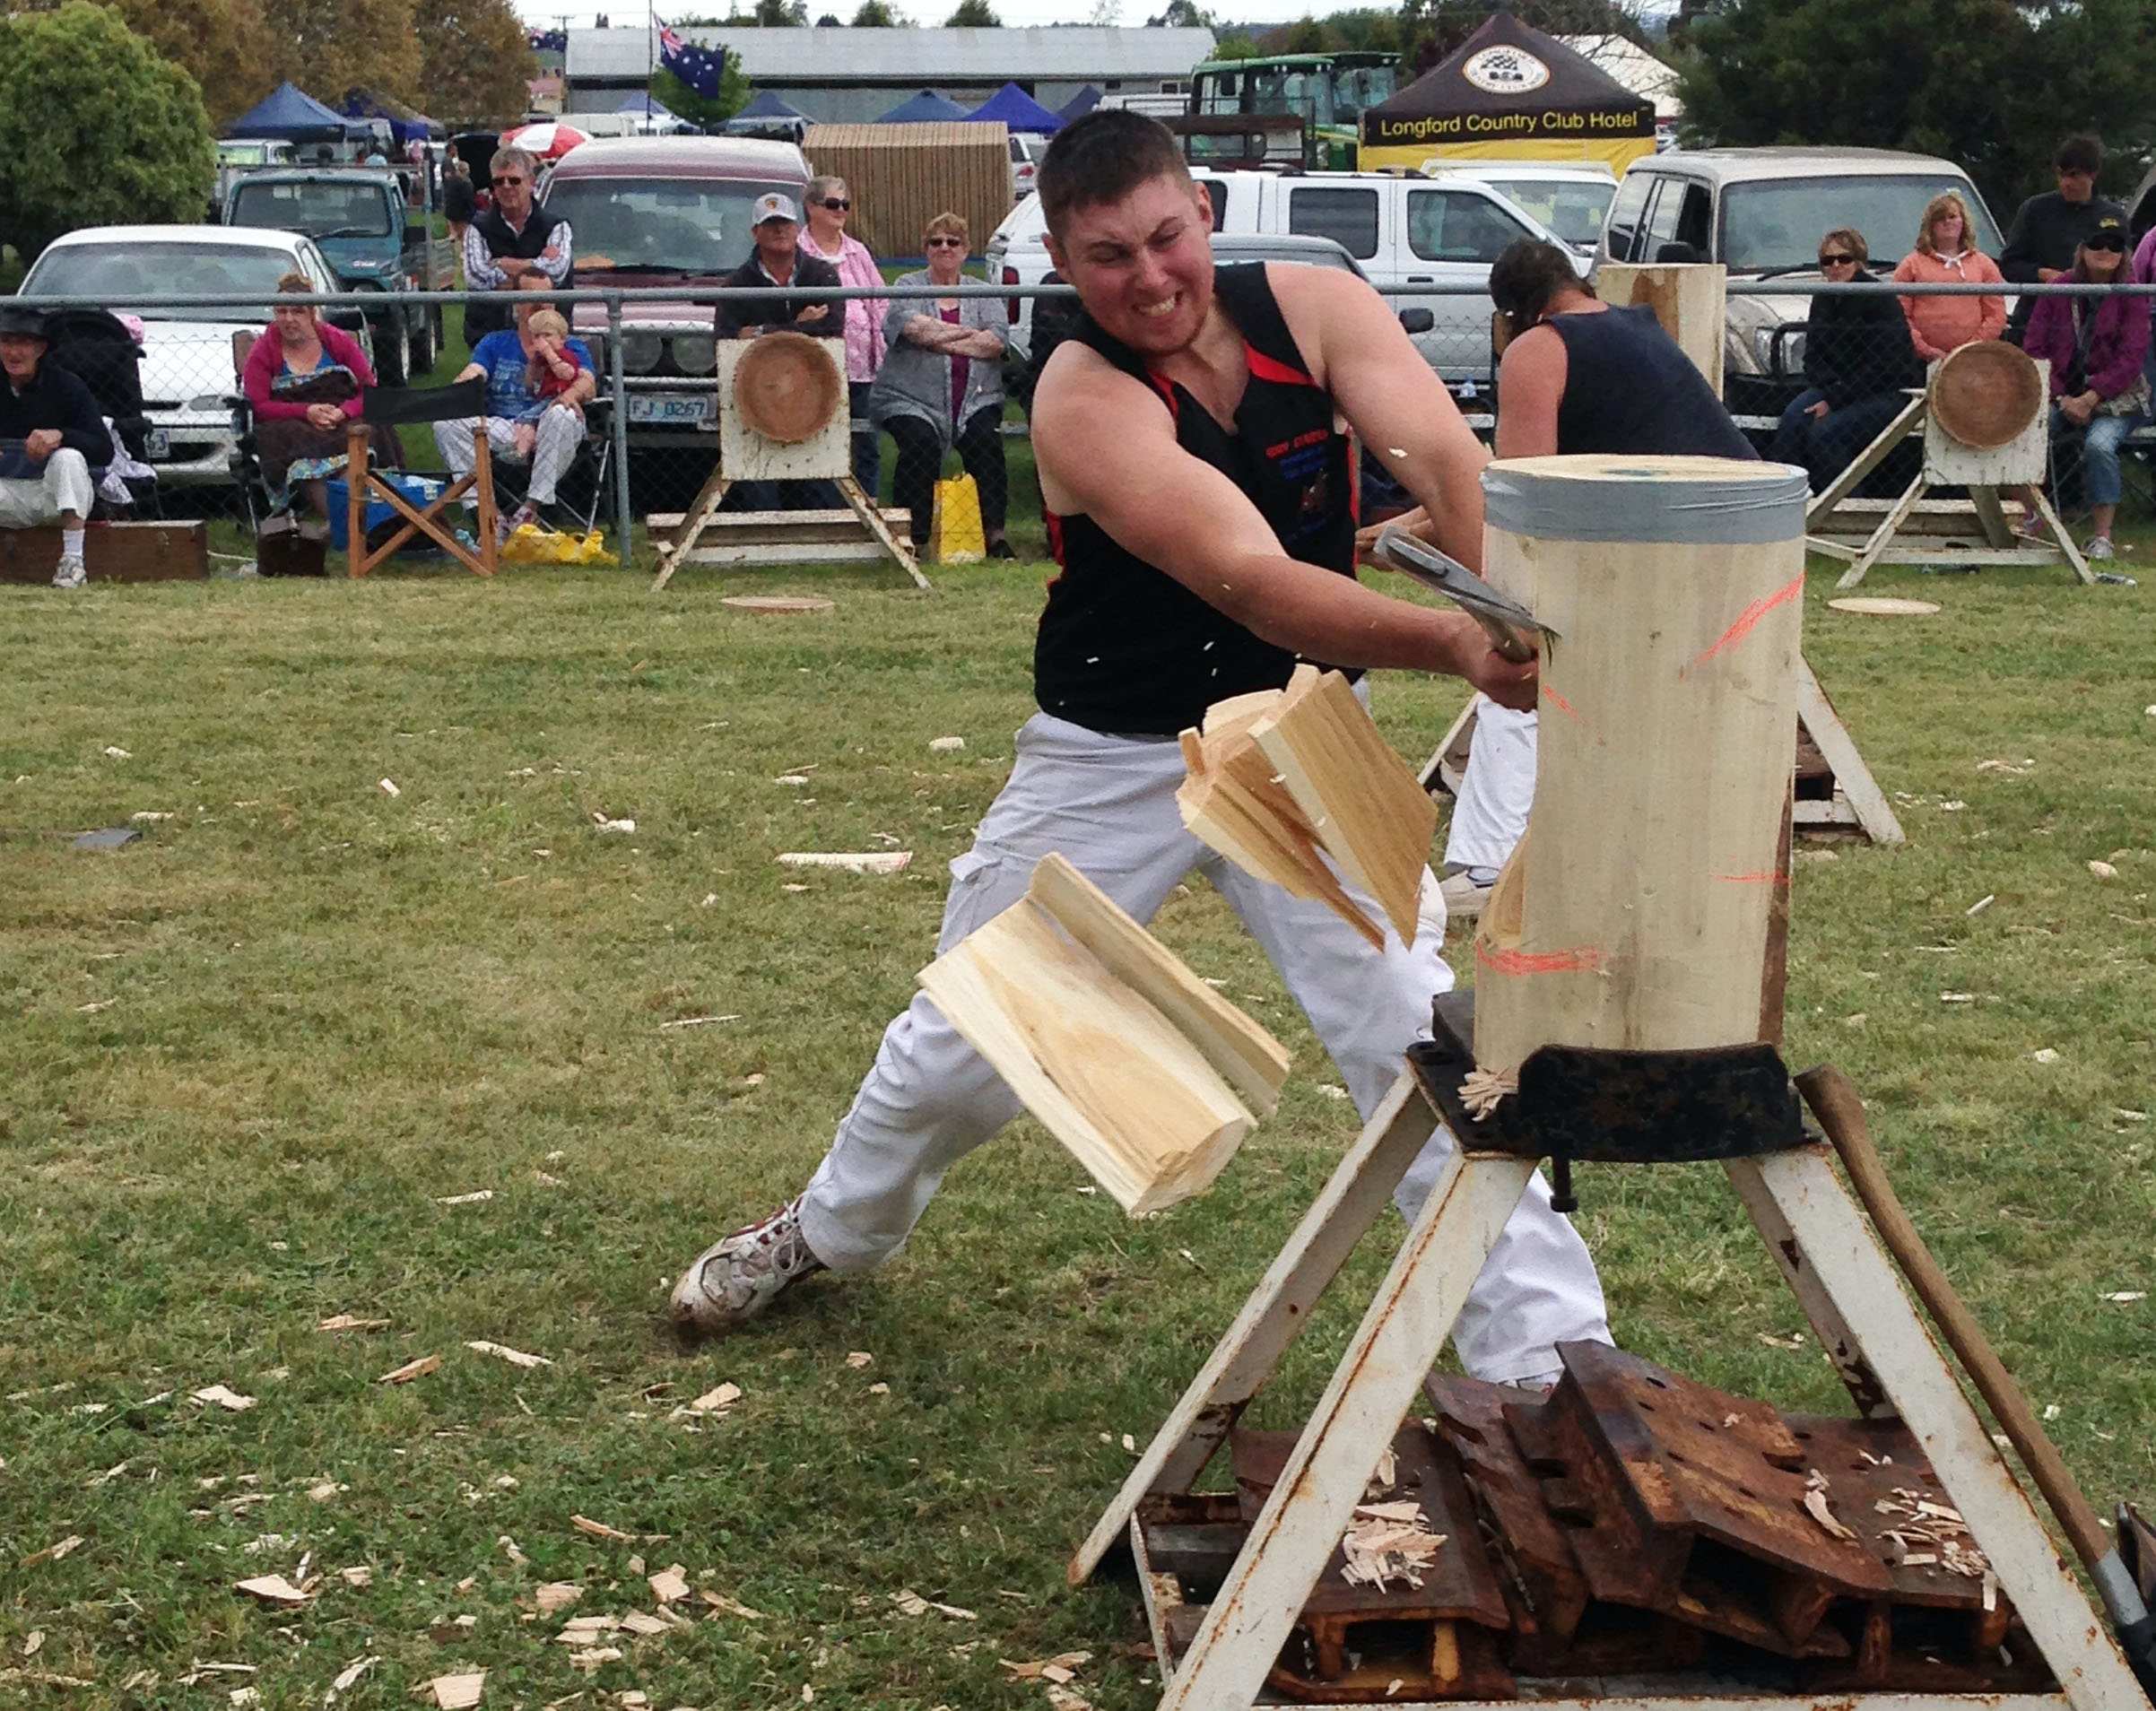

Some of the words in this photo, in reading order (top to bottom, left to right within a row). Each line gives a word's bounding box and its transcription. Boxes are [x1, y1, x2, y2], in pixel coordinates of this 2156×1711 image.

[1381, 116, 1460, 138] Longford
[1466, 114, 1537, 133] Country
[1543, 111, 1585, 128] Club
[1589, 110, 1638, 128] Hotel
